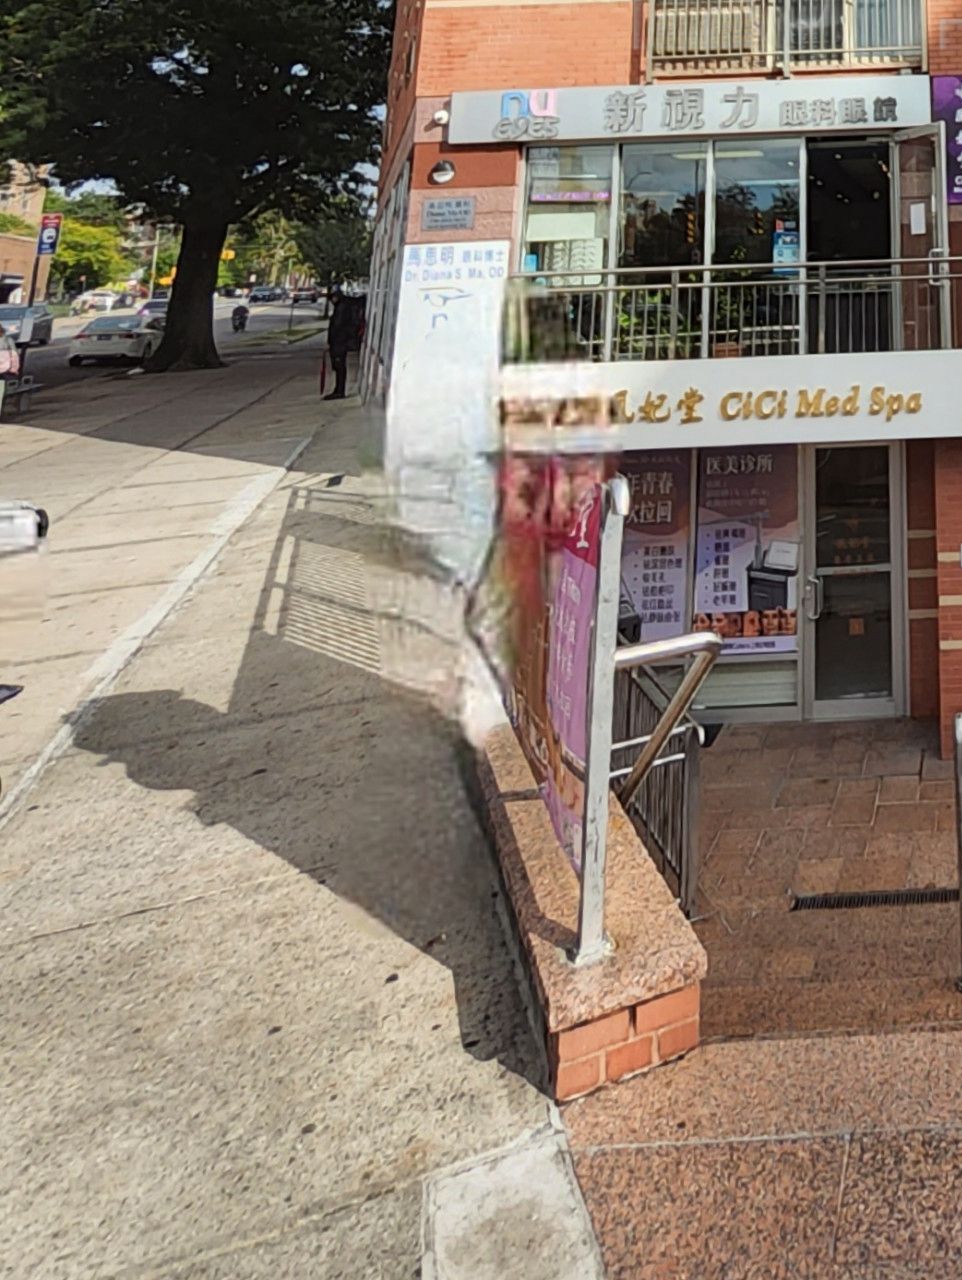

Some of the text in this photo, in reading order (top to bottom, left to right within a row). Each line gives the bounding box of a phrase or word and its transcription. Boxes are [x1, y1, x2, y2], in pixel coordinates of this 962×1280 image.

[501, 89, 558, 118] nu
[603, 86, 760, 132] 新視力
[719, 388, 788, 421] CiCi
[795, 385, 861, 419] Med
[869, 386, 922, 421] Spa
[706, 454, 773, 475] 医美诊所
